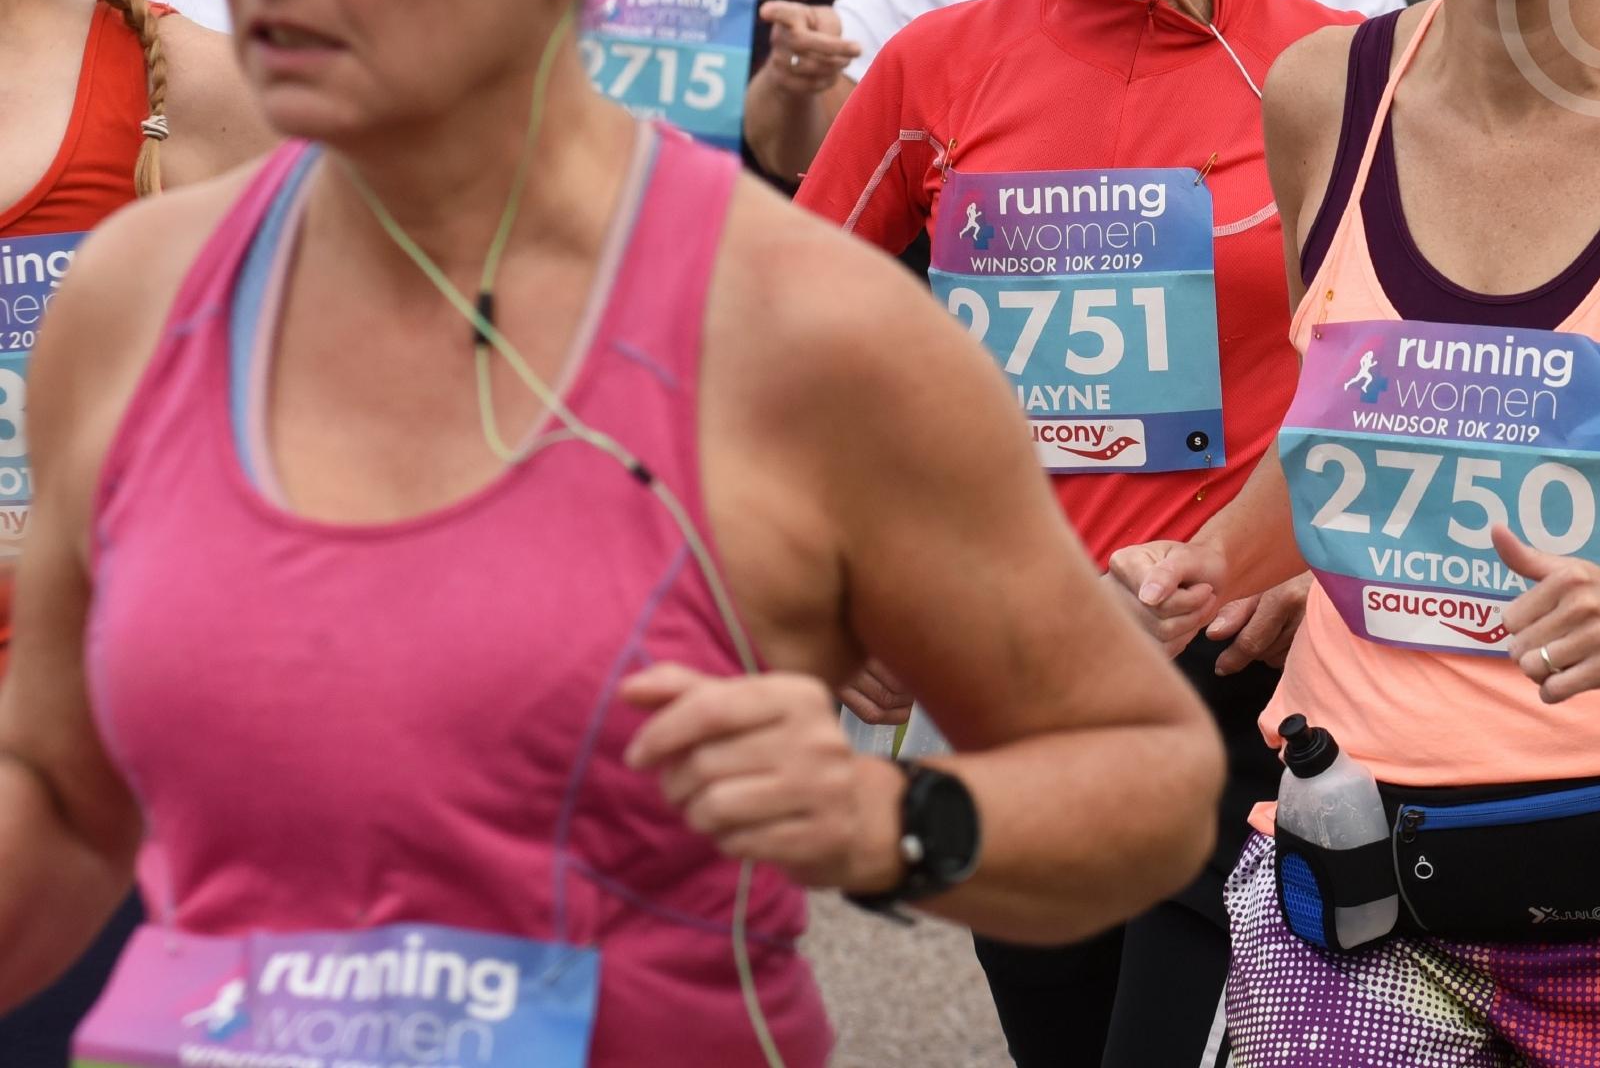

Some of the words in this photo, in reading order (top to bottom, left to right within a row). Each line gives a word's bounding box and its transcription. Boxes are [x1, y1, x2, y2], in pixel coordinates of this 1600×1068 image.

[998, 176, 1166, 218] running
[1001, 220, 1156, 251] women
[970, 256, 1057, 273] WINDSOR
[1064, 256, 1095, 272] 10K
[1101, 253, 1144, 271] 2019
[947, 286, 1169, 376] 2751
[1397, 335, 1574, 388] running
[1396, 379, 1558, 421] women
[1352, 410, 1448, 436] WINDSOR
[1456, 420, 1490, 439] 10K
[1493, 423, 1540, 443] 2019
[1305, 443, 1596, 555] 2750
[1367, 547, 1528, 592] VICTORIA
[1367, 591, 1492, 627] saucony
[258, 933, 520, 1021] running
[254, 1008, 495, 1063] women
